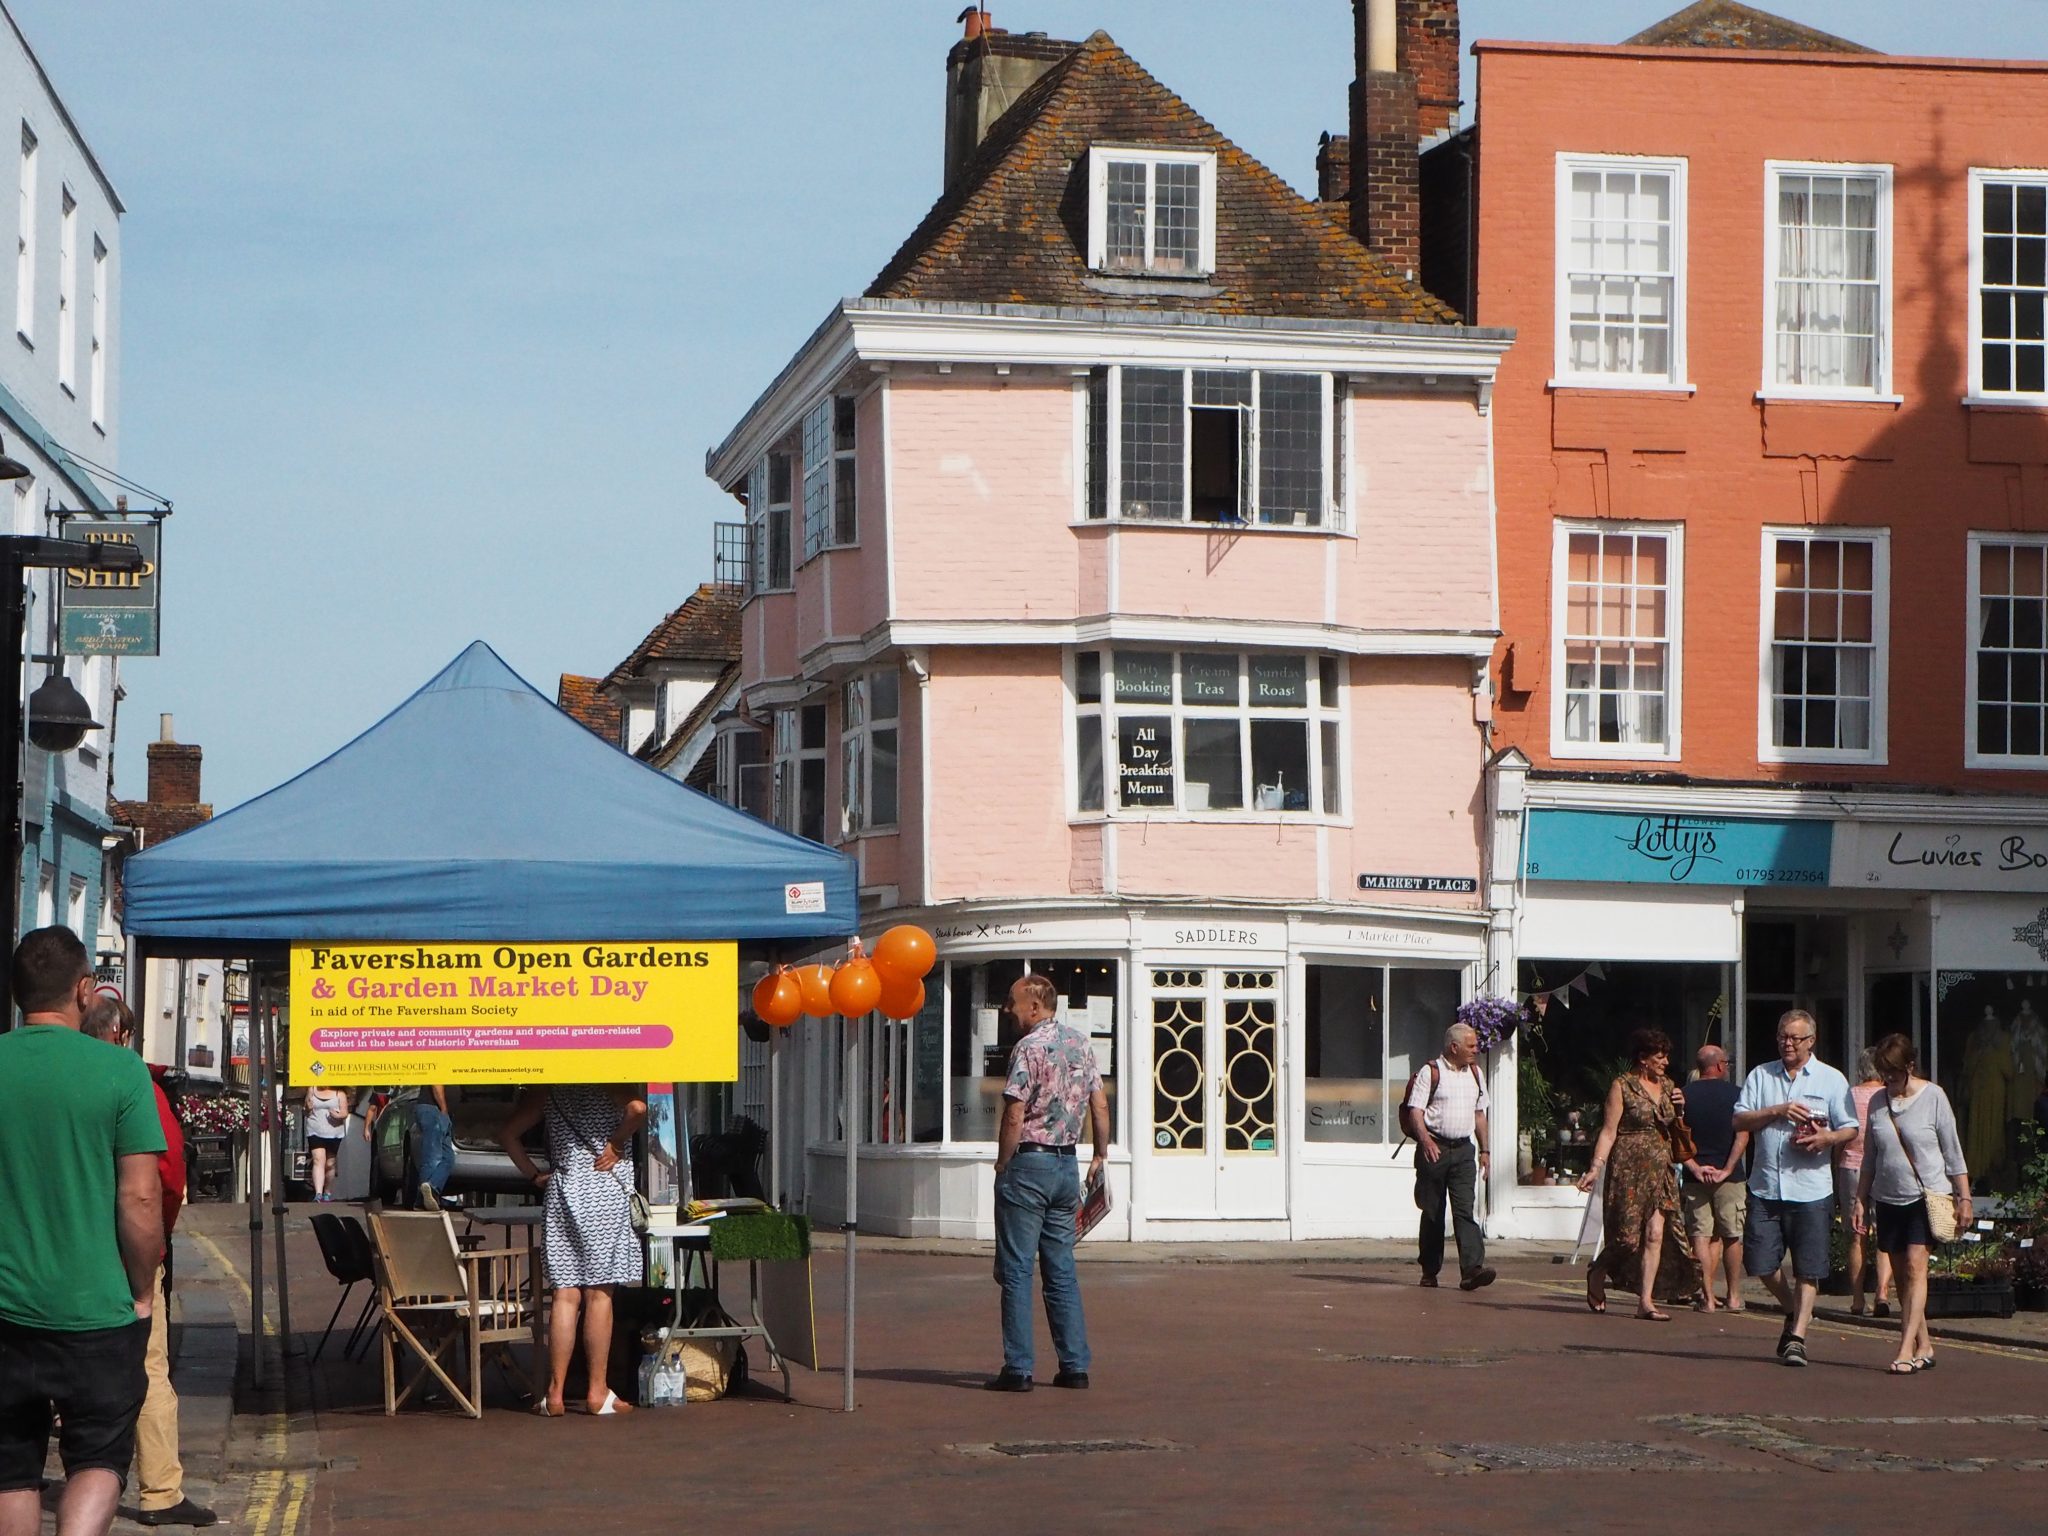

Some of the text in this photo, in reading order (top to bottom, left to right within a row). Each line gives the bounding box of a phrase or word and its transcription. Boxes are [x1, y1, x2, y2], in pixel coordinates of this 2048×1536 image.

[67, 561, 155, 588] SHIP
[1115, 680, 1170, 696] Booking
[1195, 682, 1225, 695] Teas
[1136, 728, 1155, 741] All
[1132, 746, 1159, 762] Day
[1119, 763, 1175, 777] Breakfast
[1128, 782, 1164, 795] Menu
[1614, 815, 1726, 882] Lotty's
[1888, 832, 1983, 867] Luvies
[1736, 869, 1825, 882] 01795 227564
[1365, 876, 1471, 891] MARKET PLACE
[1175, 929, 1258, 945] SADDLERS
[1359, 930, 1399, 942] Market
[1402, 933, 1432, 945] Place
[310, 946, 709, 974] Faversham Open Gardens
[97, 975, 122, 983] ONE
[311, 975, 649, 1002] & Garden Market Day
[310, 1004, 518, 1017] in aid of The Faversham Society
[320, 1026, 641, 1039] Explore private and community gardens and special garden-related
[320, 1038, 520, 1048] market in the heart of historic Faversham
[348, 1063, 400, 1071] FAVERSHAM
[402, 1062, 437, 1071] SOCIETY
